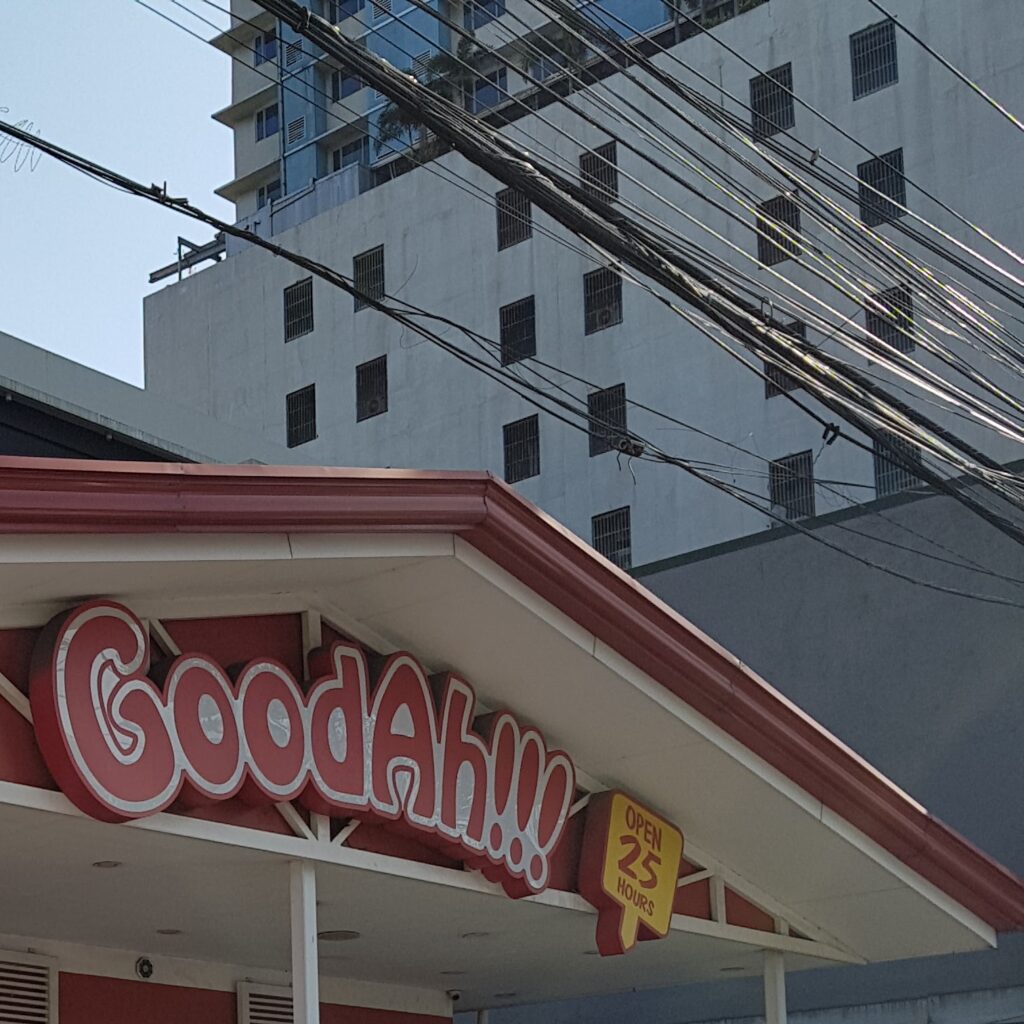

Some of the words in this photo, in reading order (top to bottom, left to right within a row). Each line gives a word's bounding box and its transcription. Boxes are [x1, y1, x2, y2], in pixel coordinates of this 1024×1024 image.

[625, 805, 662, 852] OPEN
[618, 834, 662, 889] 25
[617, 876, 655, 917] HOURS
